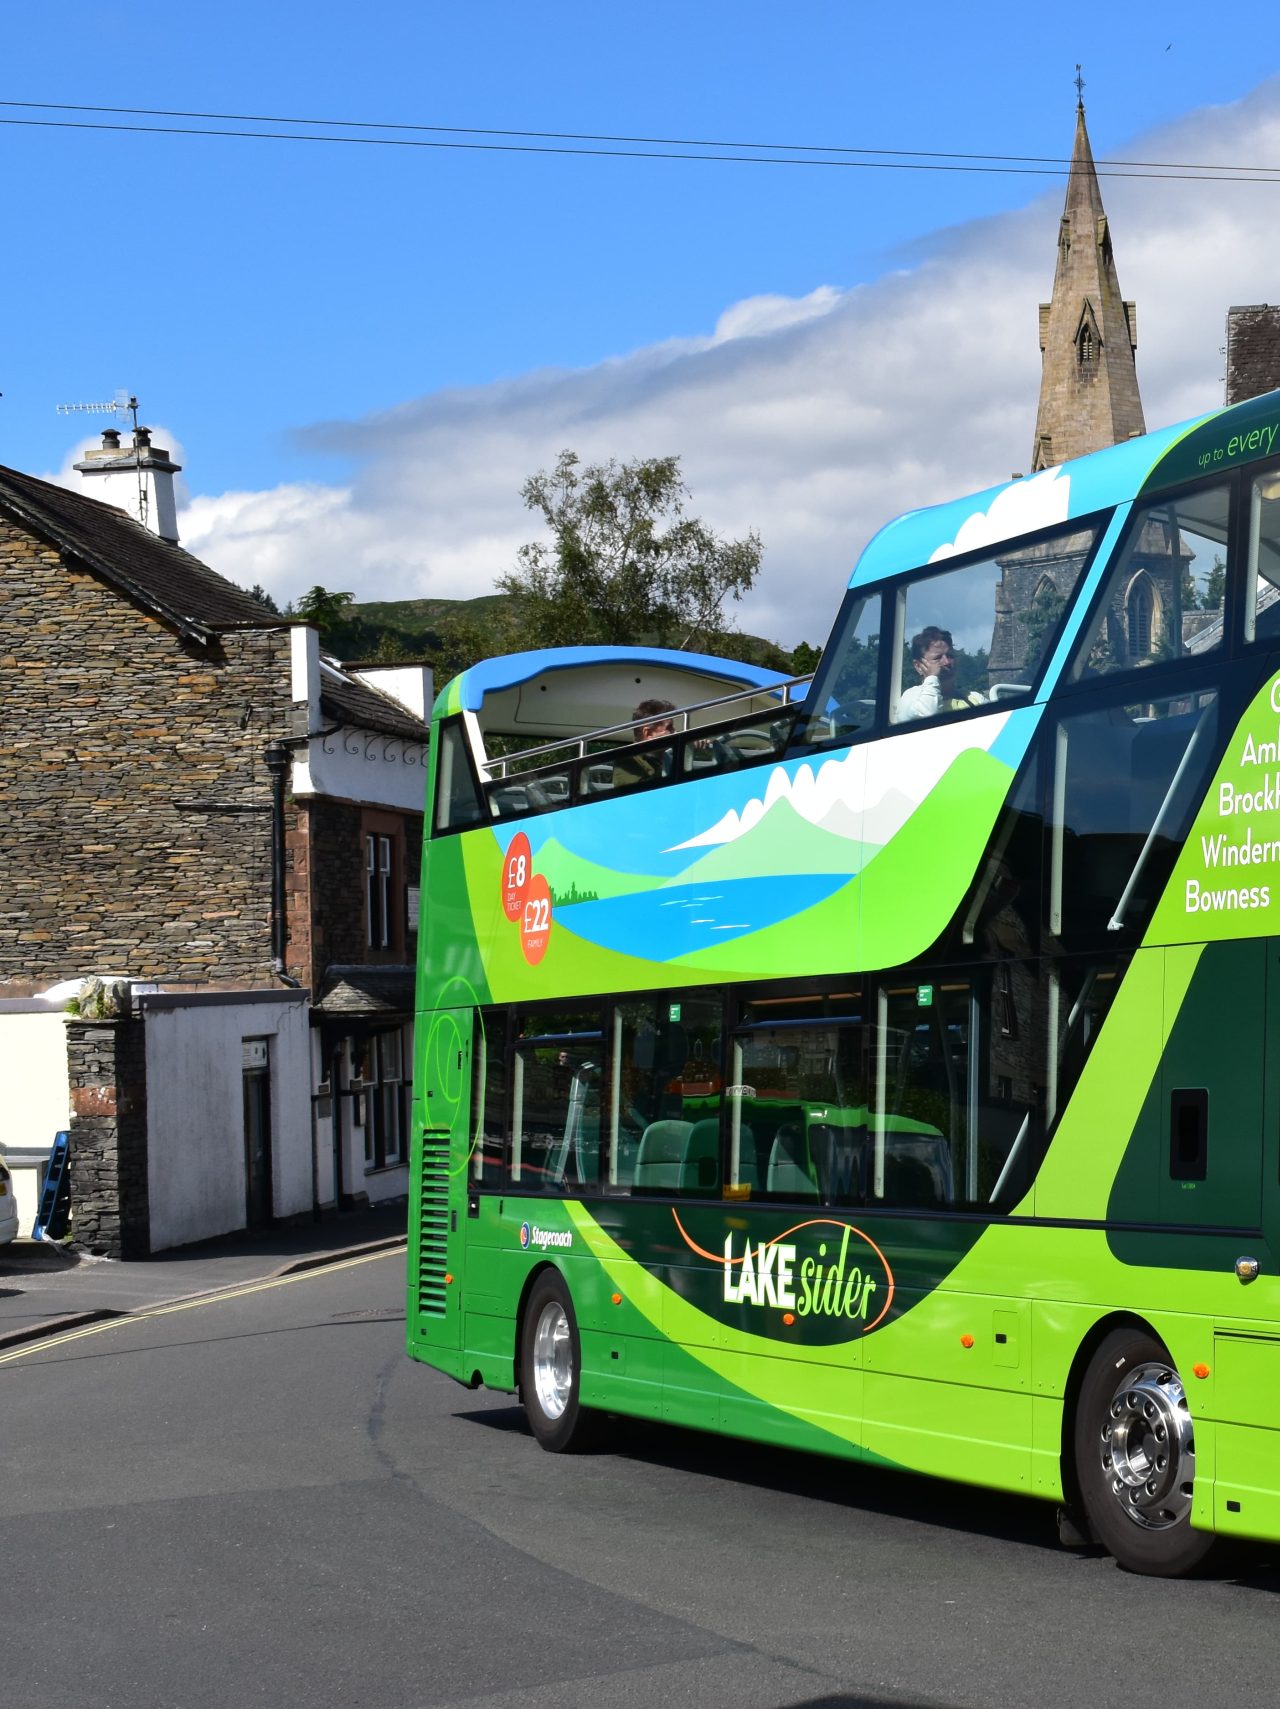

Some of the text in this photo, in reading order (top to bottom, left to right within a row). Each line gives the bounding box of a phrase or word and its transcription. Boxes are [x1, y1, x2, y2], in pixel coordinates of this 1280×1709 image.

[1198, 452, 1211, 469] up
[1213, 447, 1224, 461] to
[1227, 423, 1279, 455] every
[508, 854, 526, 888] £8
[1185, 879, 1270, 913] Bowness
[524, 898, 549, 933] £22
[531, 1226, 573, 1250] Stagecoach
